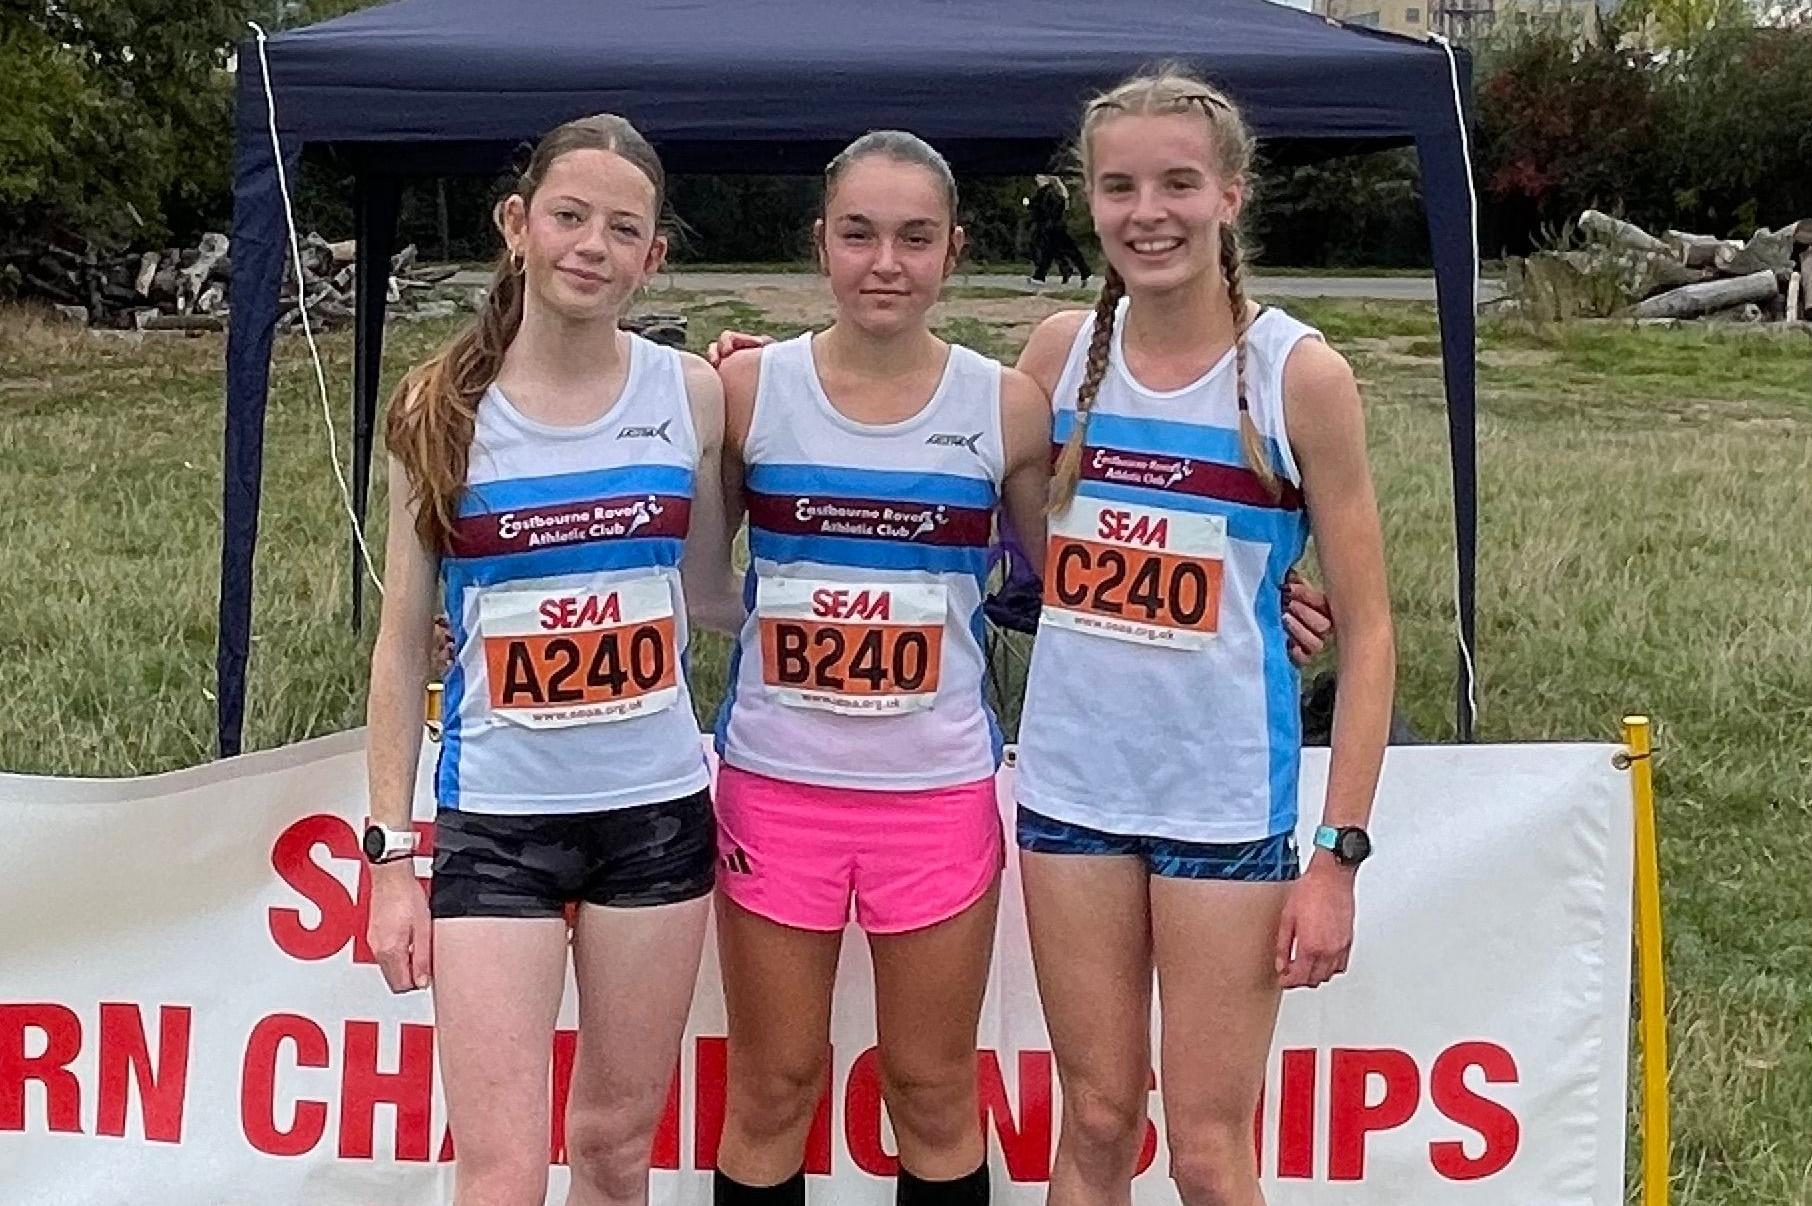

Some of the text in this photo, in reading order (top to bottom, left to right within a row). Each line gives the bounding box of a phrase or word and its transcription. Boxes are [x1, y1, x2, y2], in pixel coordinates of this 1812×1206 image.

[498, 512, 590, 539] Eastbourne
[795, 498, 880, 521] Eastbourne
[528, 522, 625, 546] Athletic Club
[820, 519, 910, 537] Athletic Club
[1098, 509, 1169, 549] SEAA
[1056, 544, 1208, 625] C240
[539, 591, 621, 629] SEAA
[812, 588, 891, 621] SEAA
[502, 625, 664, 704] A240
[776, 623, 928, 691] B240
